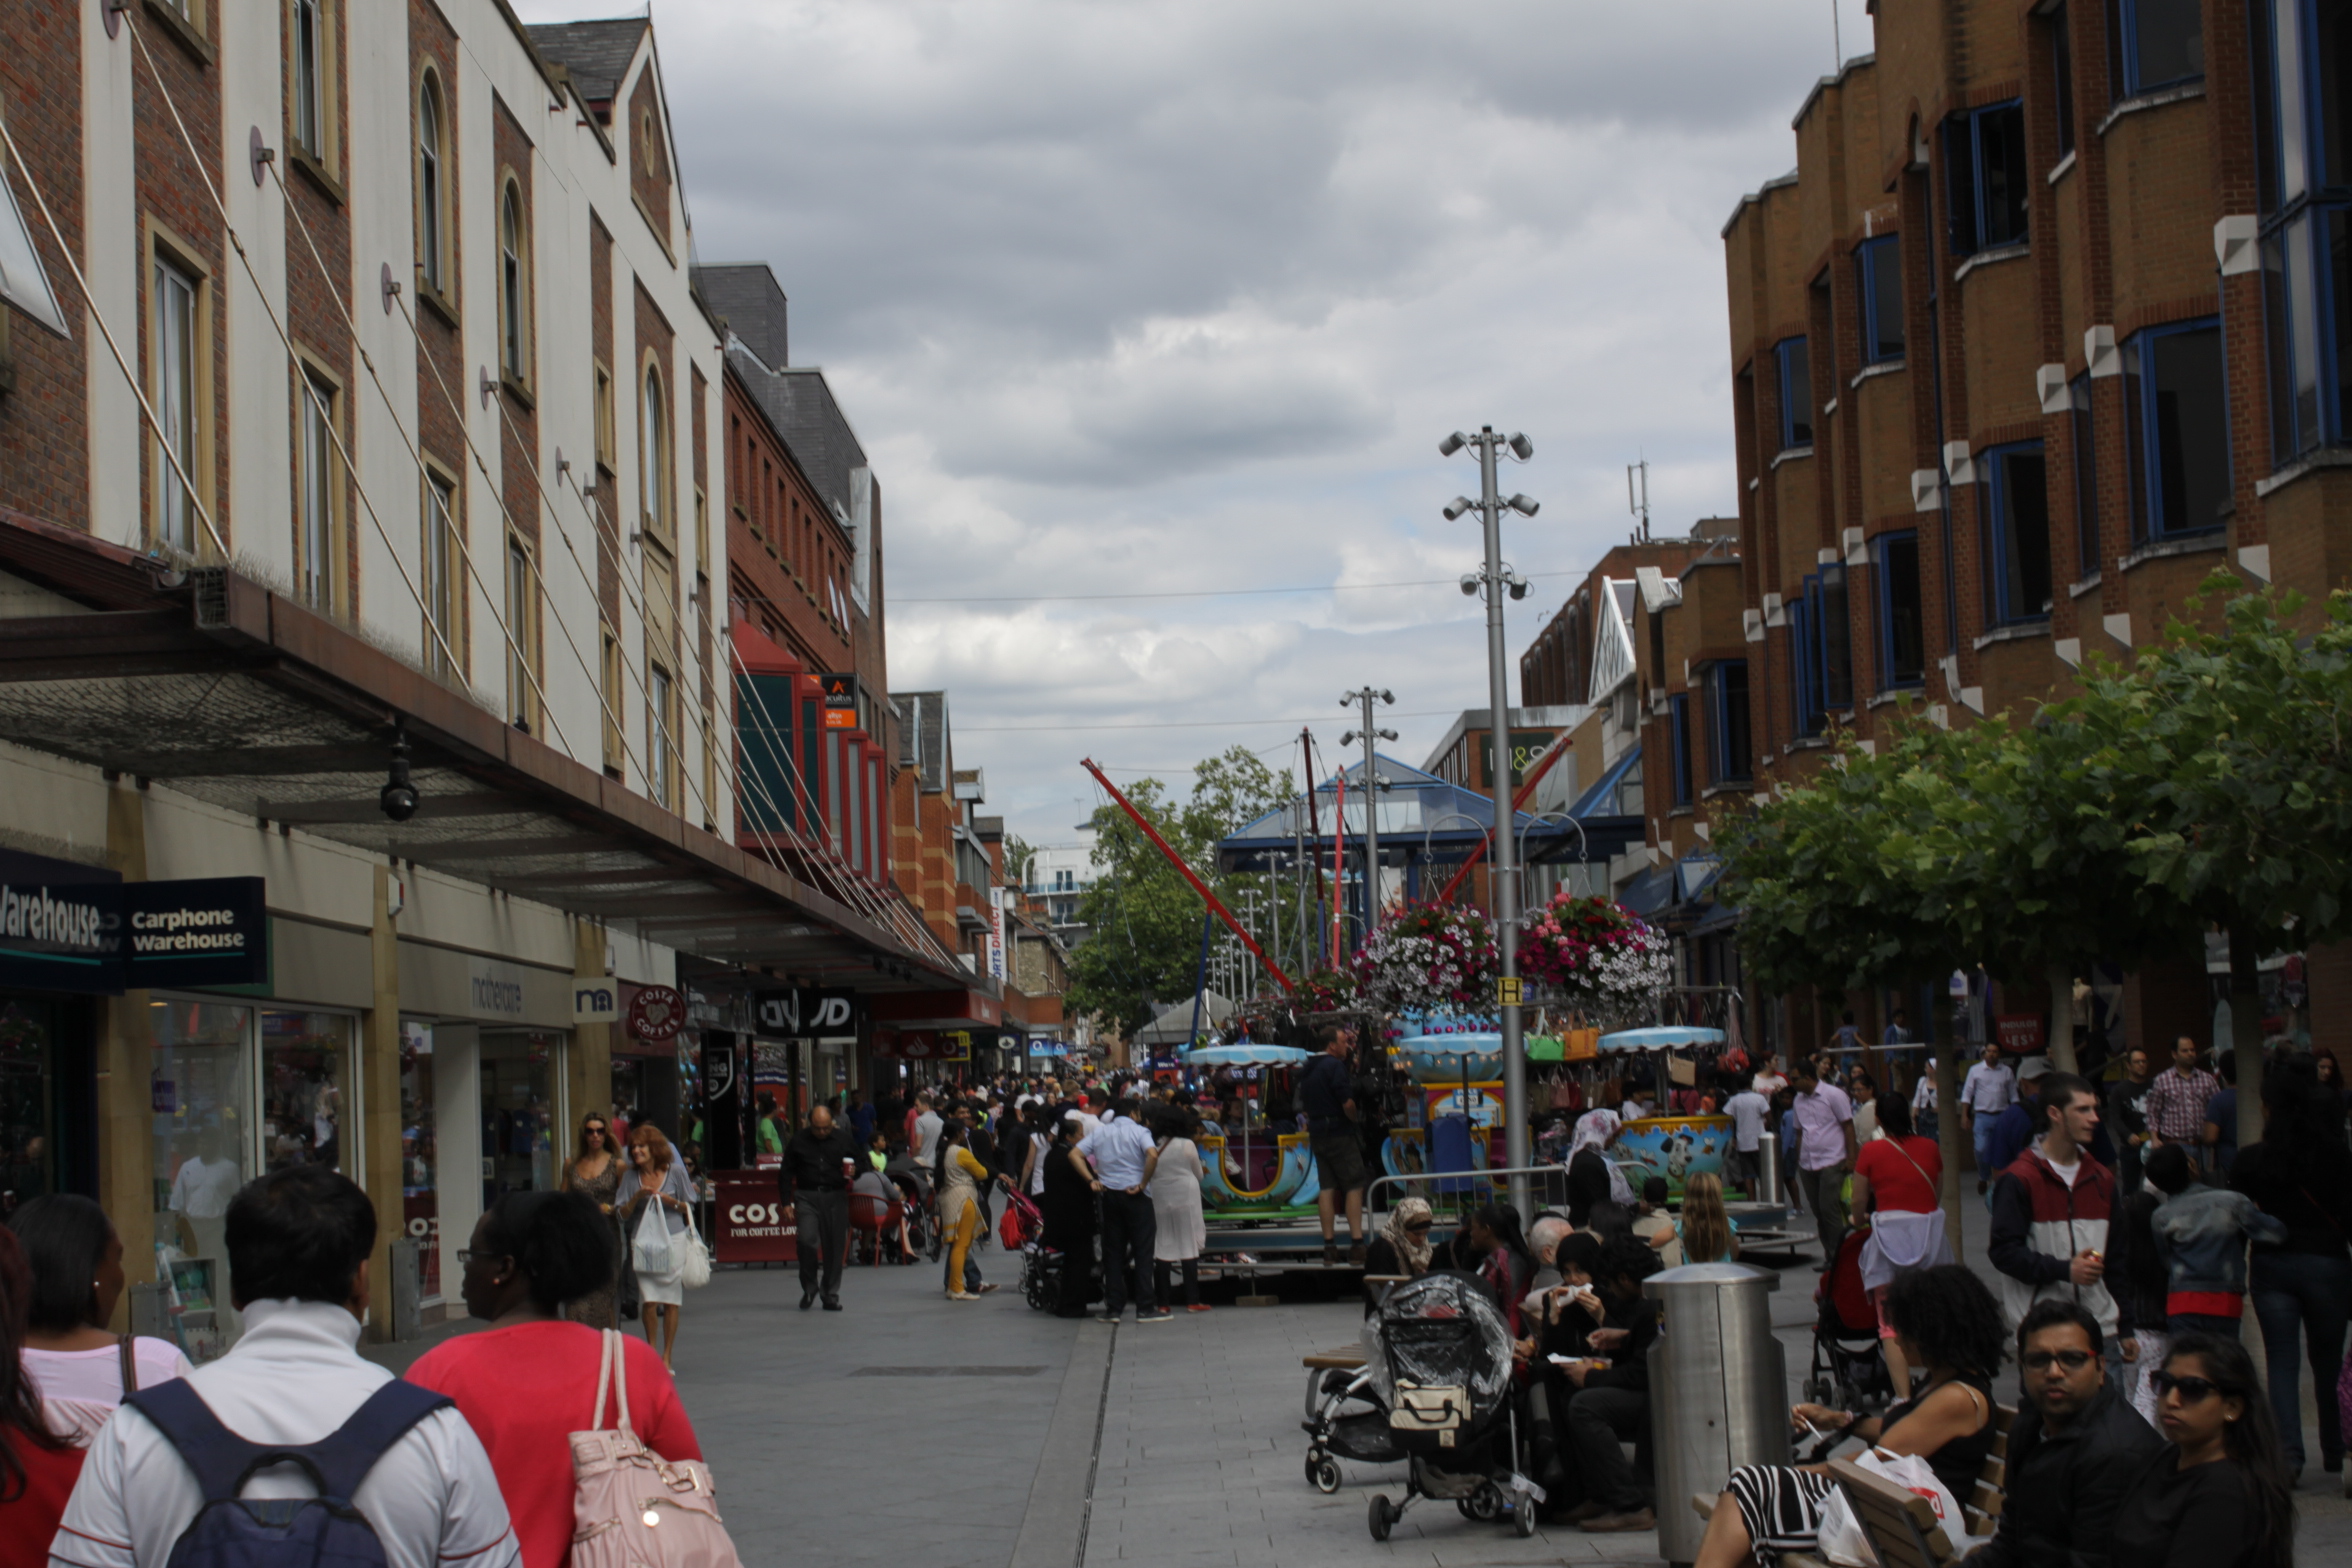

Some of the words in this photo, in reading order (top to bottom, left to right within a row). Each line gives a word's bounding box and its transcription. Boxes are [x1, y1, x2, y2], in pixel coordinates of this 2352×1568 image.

[132, 908, 234, 931] Carphone
[133, 932, 245, 952] Warehouse
[639, 990, 673, 1005] COSTA
[1502, 981, 1519, 1002] H
[810, 997, 851, 1027] JD
[637, 1018, 680, 1036] COFFEE
[2005, 1034, 2035, 1047] LESS
[729, 1203, 780, 1225] COS
[731, 1228, 748, 1238] FOR
[749, 1227, 780, 1237] COFFEE
